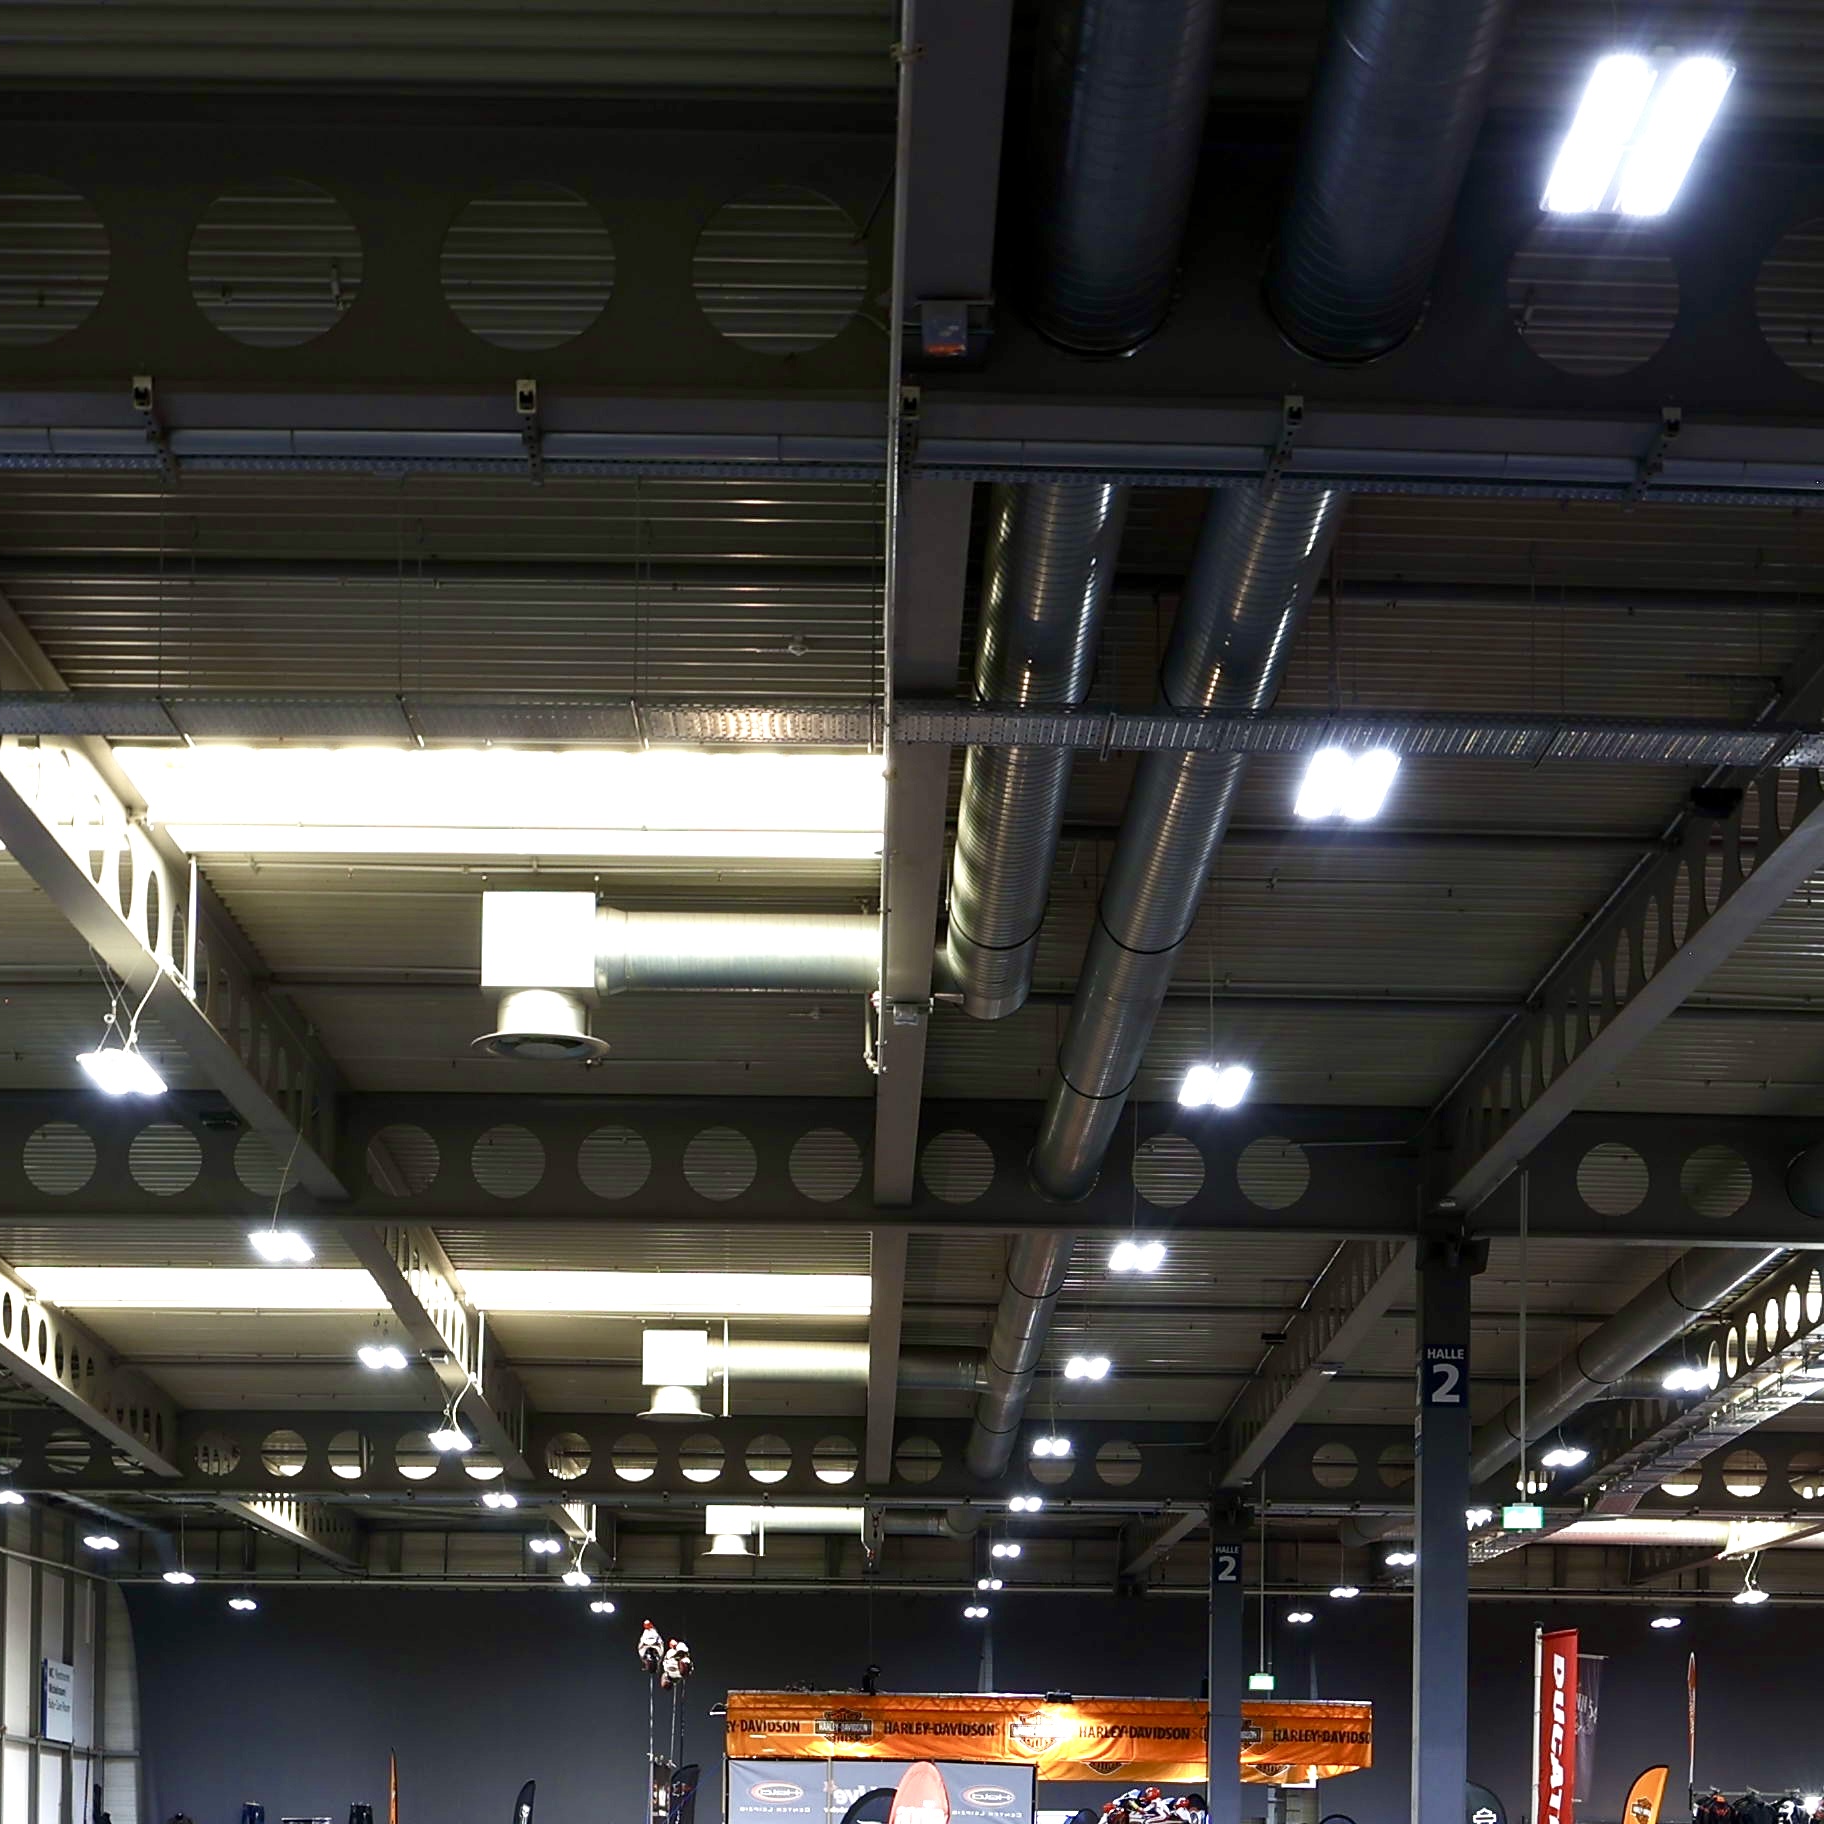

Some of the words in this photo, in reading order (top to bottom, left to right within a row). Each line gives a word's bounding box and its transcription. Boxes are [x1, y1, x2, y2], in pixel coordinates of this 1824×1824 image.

[1427, 1347, 1464, 1360] HALLE
[1431, 1363, 1460, 1403] 2
[1218, 1556, 1237, 1581] 2
[884, 1721, 994, 1736] HARLEY-DAVIDSON
